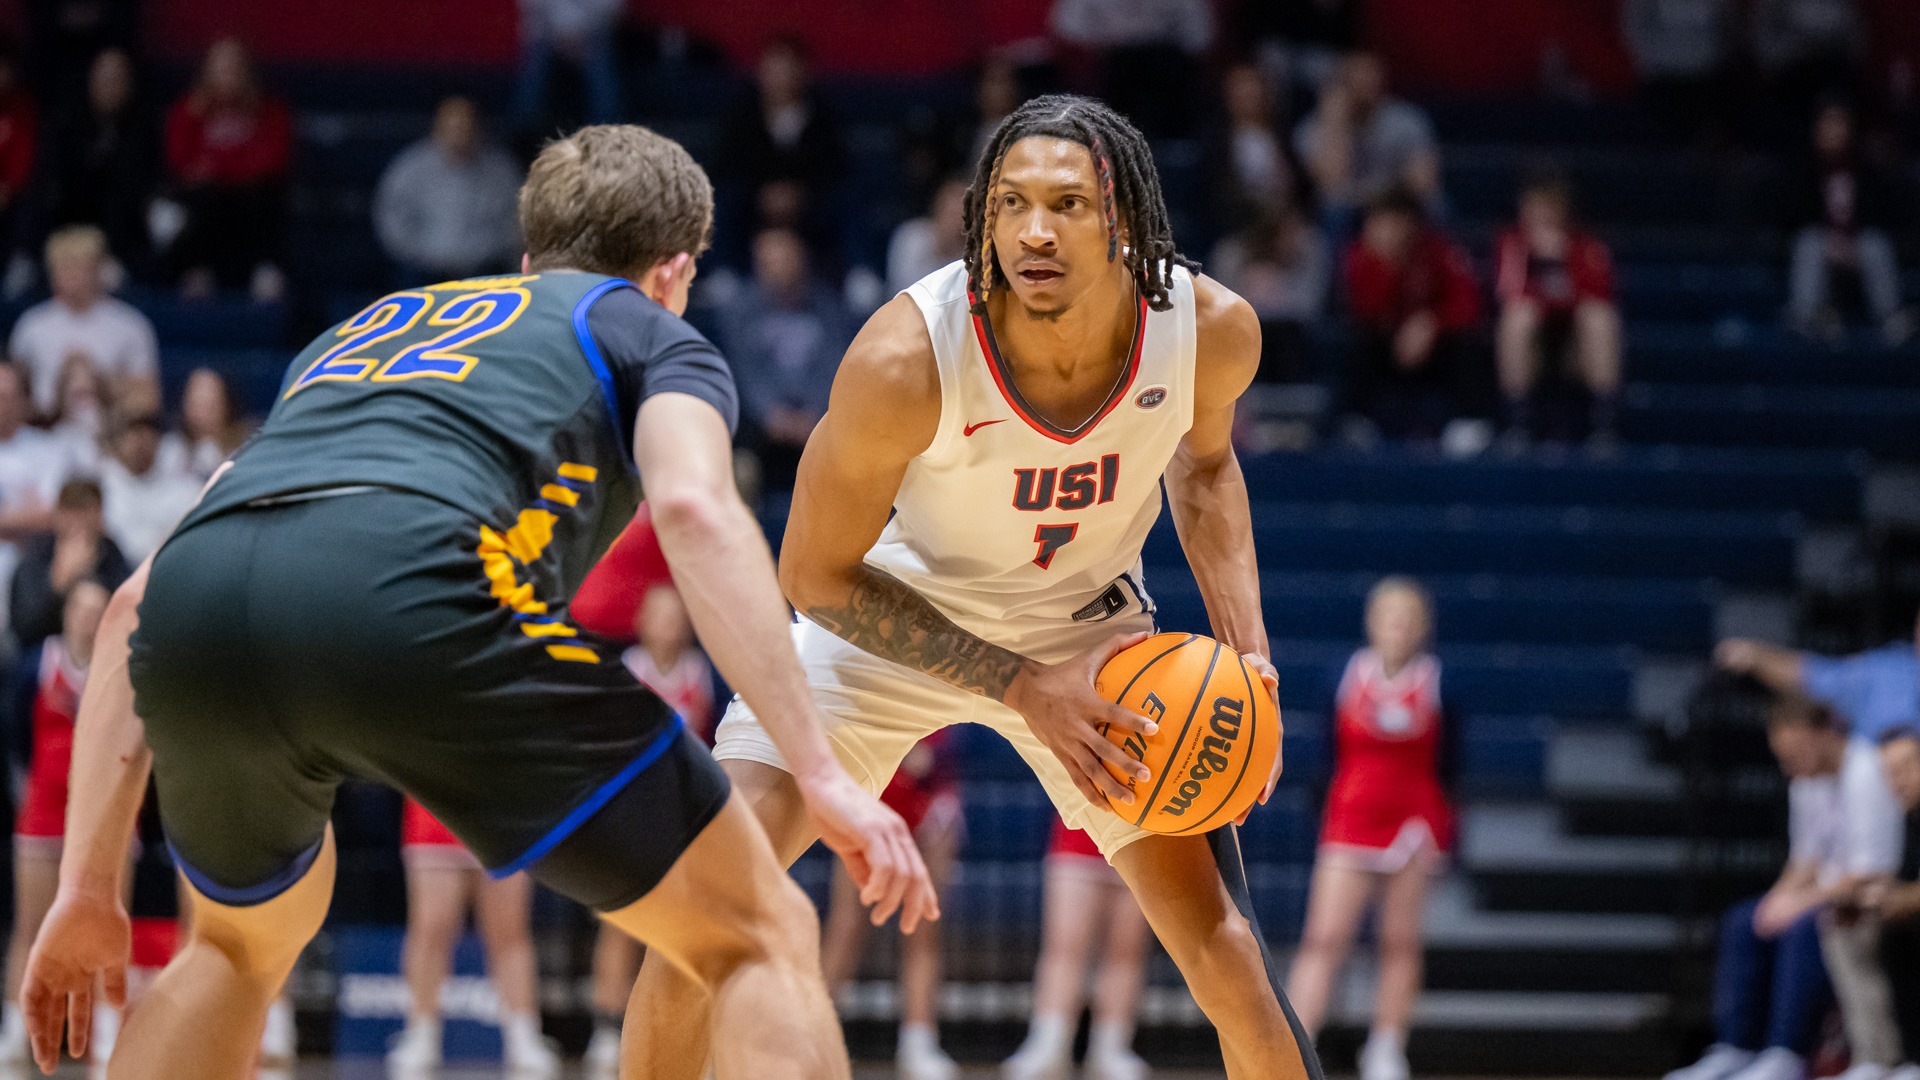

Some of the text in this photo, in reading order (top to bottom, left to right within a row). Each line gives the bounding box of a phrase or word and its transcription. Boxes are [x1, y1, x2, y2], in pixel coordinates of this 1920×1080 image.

[282, 287, 532, 401] 22
[1012, 453, 1120, 512] USI
[1109, 597, 1119, 607] L
[1160, 696, 1245, 817] Wilson
[1173, 725, 1203, 784] INDOOR GAME BALL
